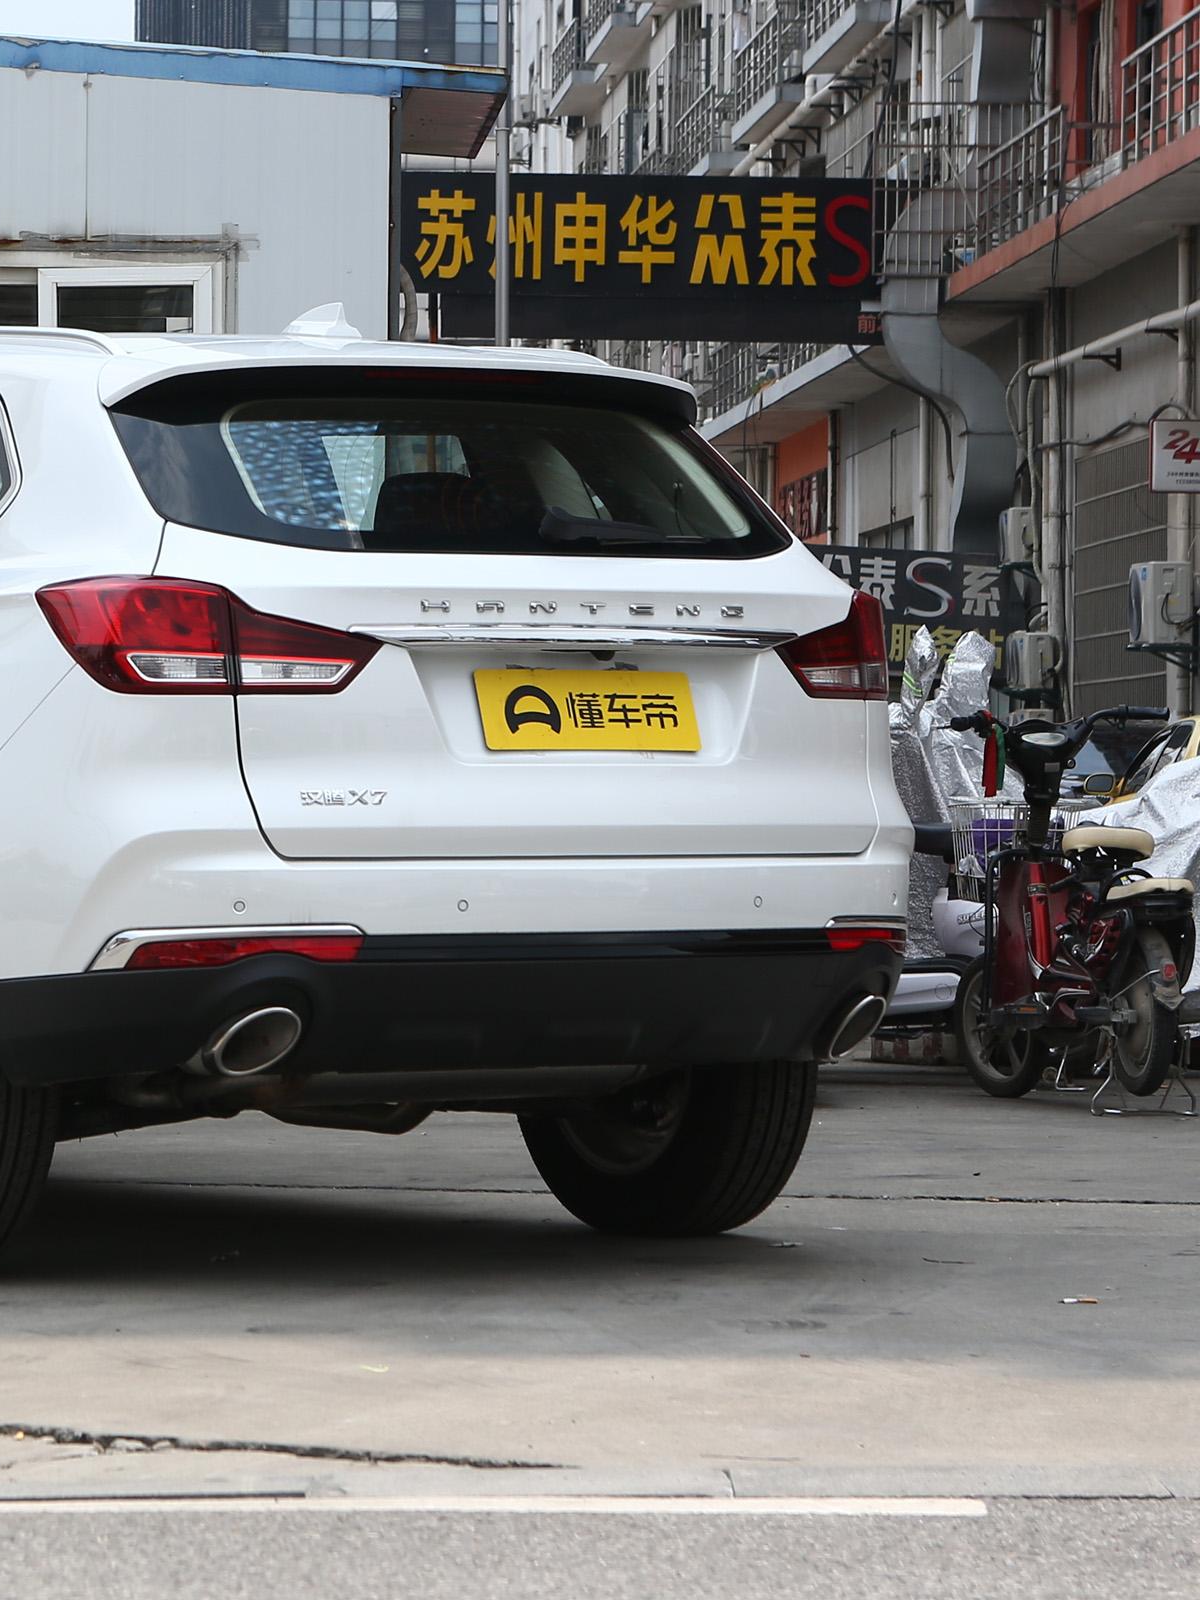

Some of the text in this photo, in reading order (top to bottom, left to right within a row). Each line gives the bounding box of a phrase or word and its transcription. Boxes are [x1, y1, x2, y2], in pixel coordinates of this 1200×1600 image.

[420, 599, 745, 618] HANTENG
[565, 691, 678, 729] 懂车帝
[347, 789, 388, 806] X7
